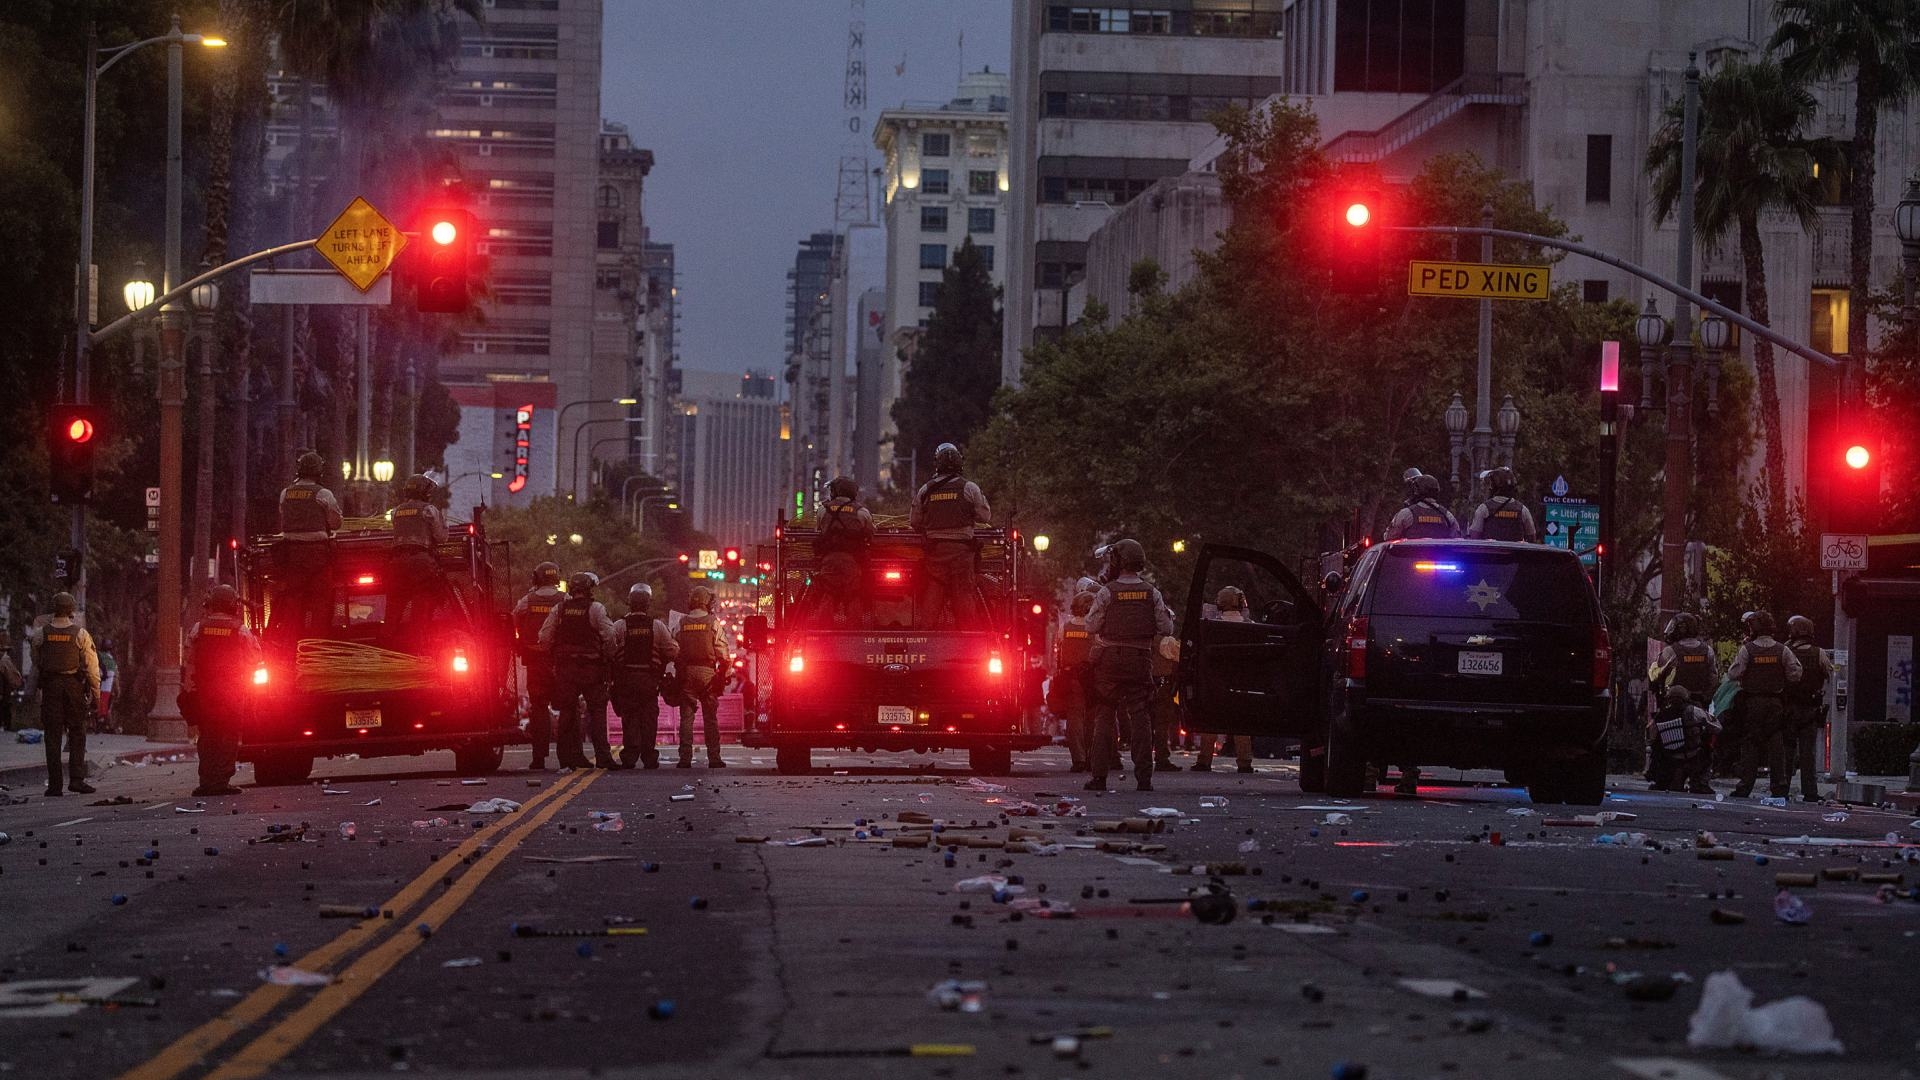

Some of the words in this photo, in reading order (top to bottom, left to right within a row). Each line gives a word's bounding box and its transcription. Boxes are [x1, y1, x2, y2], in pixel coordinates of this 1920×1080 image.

[334, 229, 357, 239] LEFT
[363, 228, 389, 238] LANE
[332, 242, 364, 252] TURNS
[370, 241, 391, 251] LEFT
[347, 256, 380, 265] AHEAD
[1421, 268, 1469, 290] PED
[1481, 271, 1538, 293] XING
[515, 411, 530, 476] PARK
[930, 492, 958, 501] SHERIFF
[1581, 510, 1599, 520] Tokyo
[1584, 526, 1596, 534] Hill
[1117, 591, 1148, 600] SHERIFF
[866, 654, 927, 664] SHERIFF
